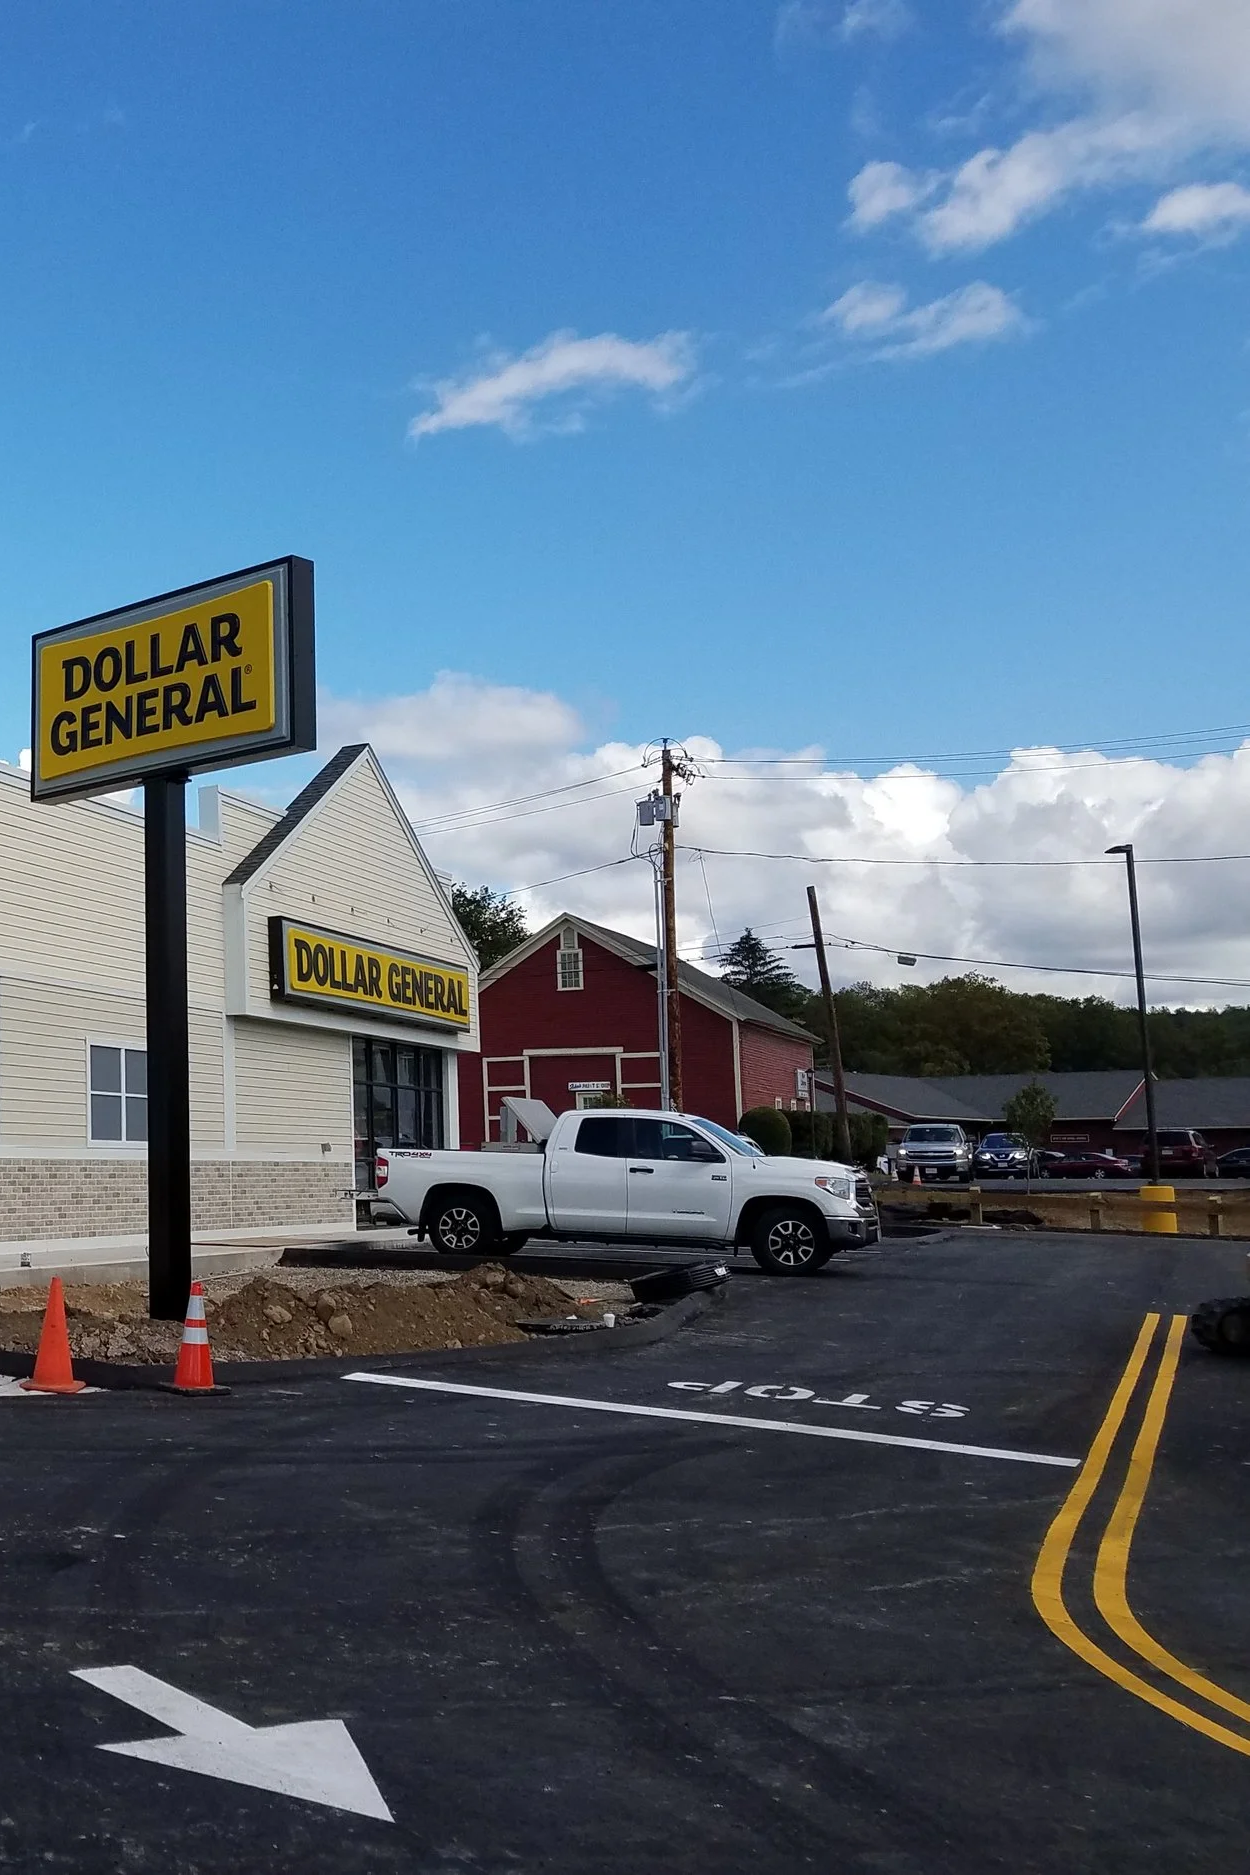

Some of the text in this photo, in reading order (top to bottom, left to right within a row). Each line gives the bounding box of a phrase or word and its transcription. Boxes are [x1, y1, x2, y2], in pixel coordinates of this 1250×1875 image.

[62, 612, 243, 702] DOLLAR
[50, 666, 257, 756] GENERAL
[294, 938, 467, 1016] DOLLAR GENERAL
[667, 1380, 971, 1417] STOP
